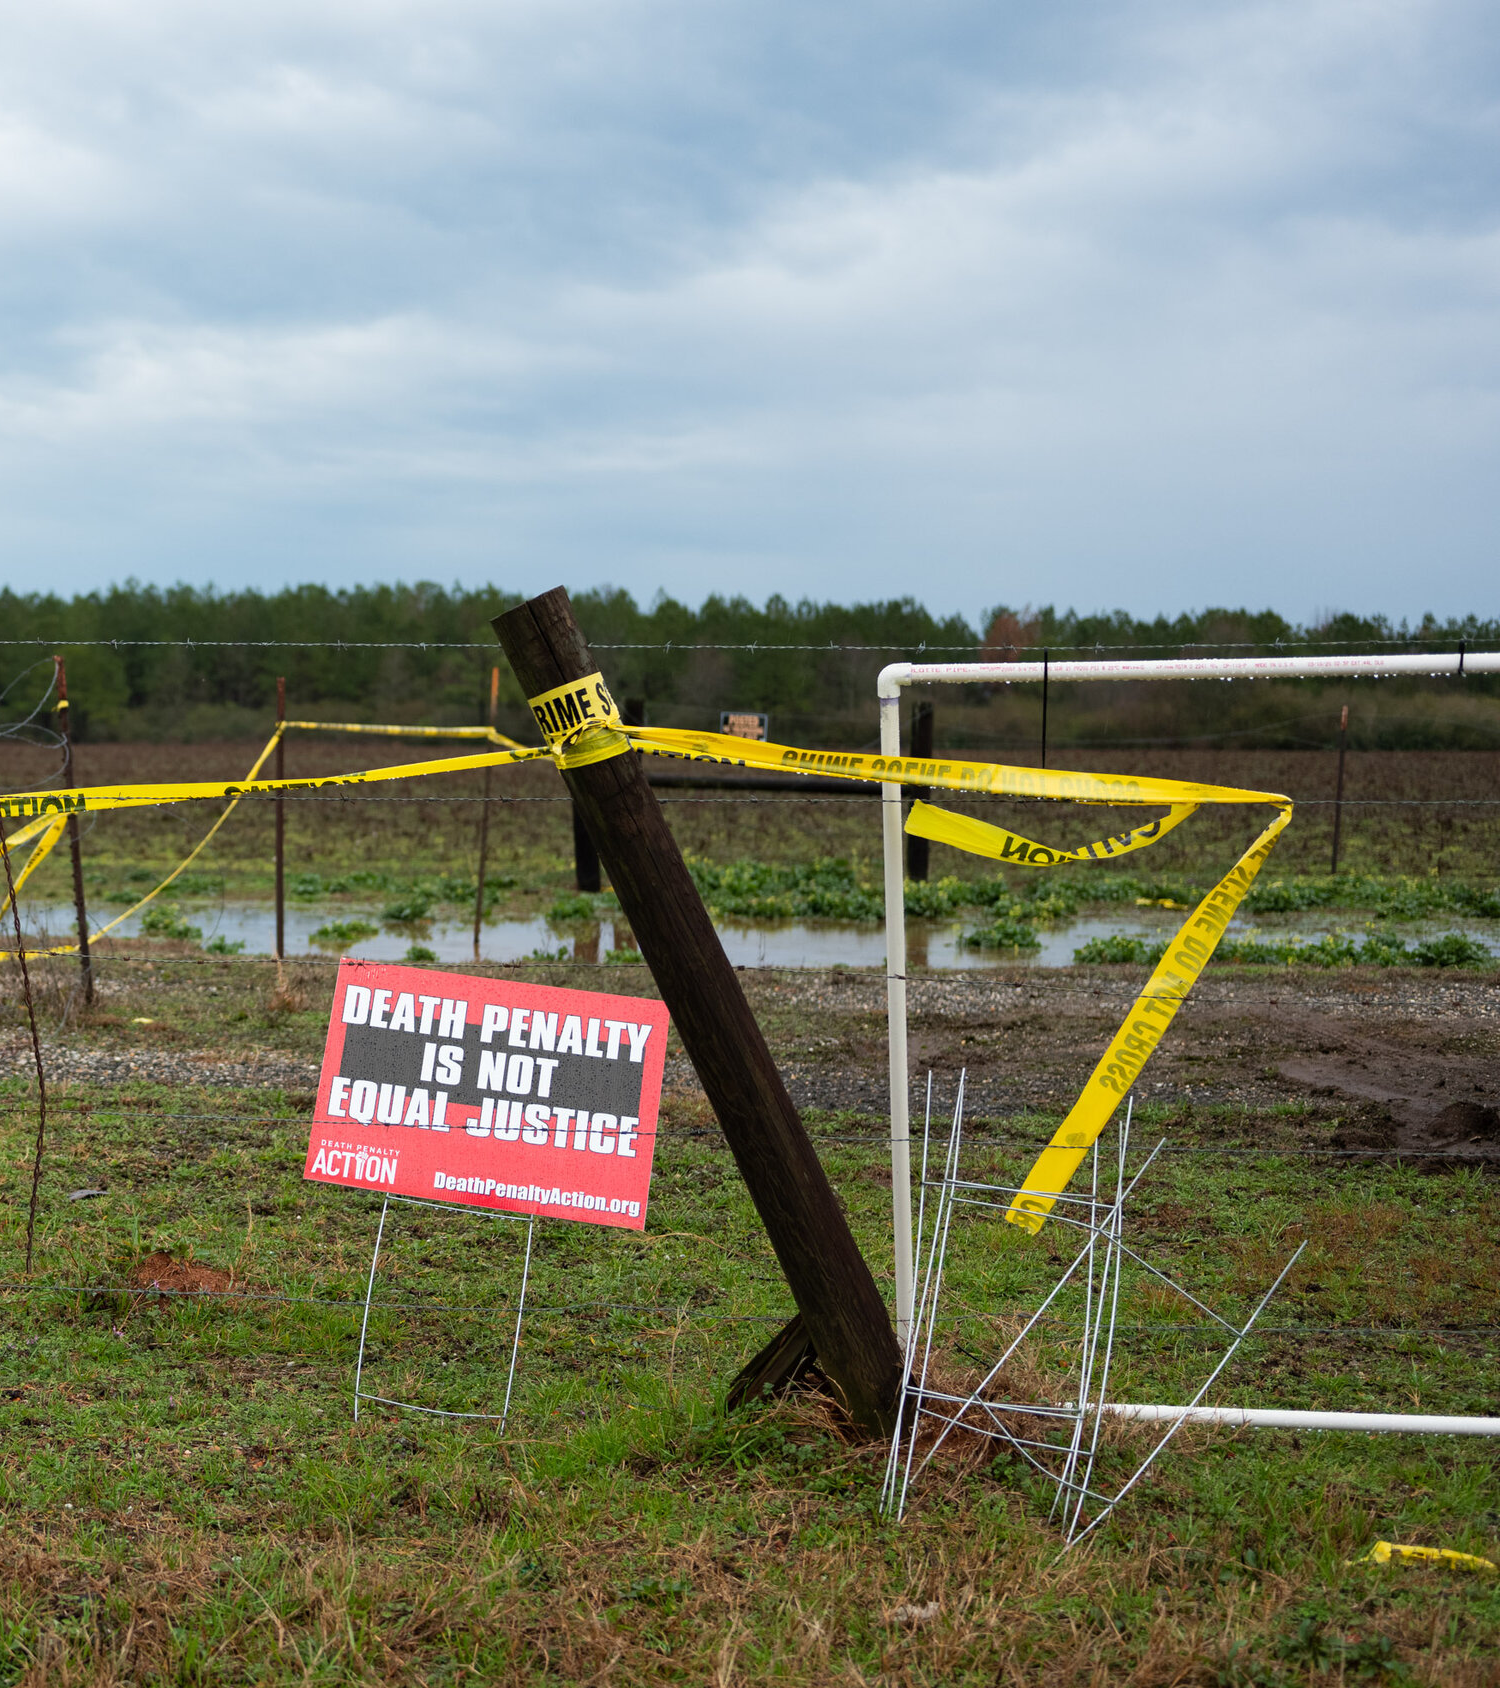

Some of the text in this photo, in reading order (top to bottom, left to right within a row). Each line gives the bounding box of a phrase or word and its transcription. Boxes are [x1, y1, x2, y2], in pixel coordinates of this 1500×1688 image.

[341, 984, 653, 1063] DEATH PENALTY
[419, 1042, 560, 1098] IS NOT
[327, 1075, 640, 1158] EQUAL JUSTICE
[310, 1148, 398, 1185] ACTION
[321, 1139, 400, 1157] DEATH PENALTY
[433, 1171, 641, 1218] DeathPenaltyAction.org
